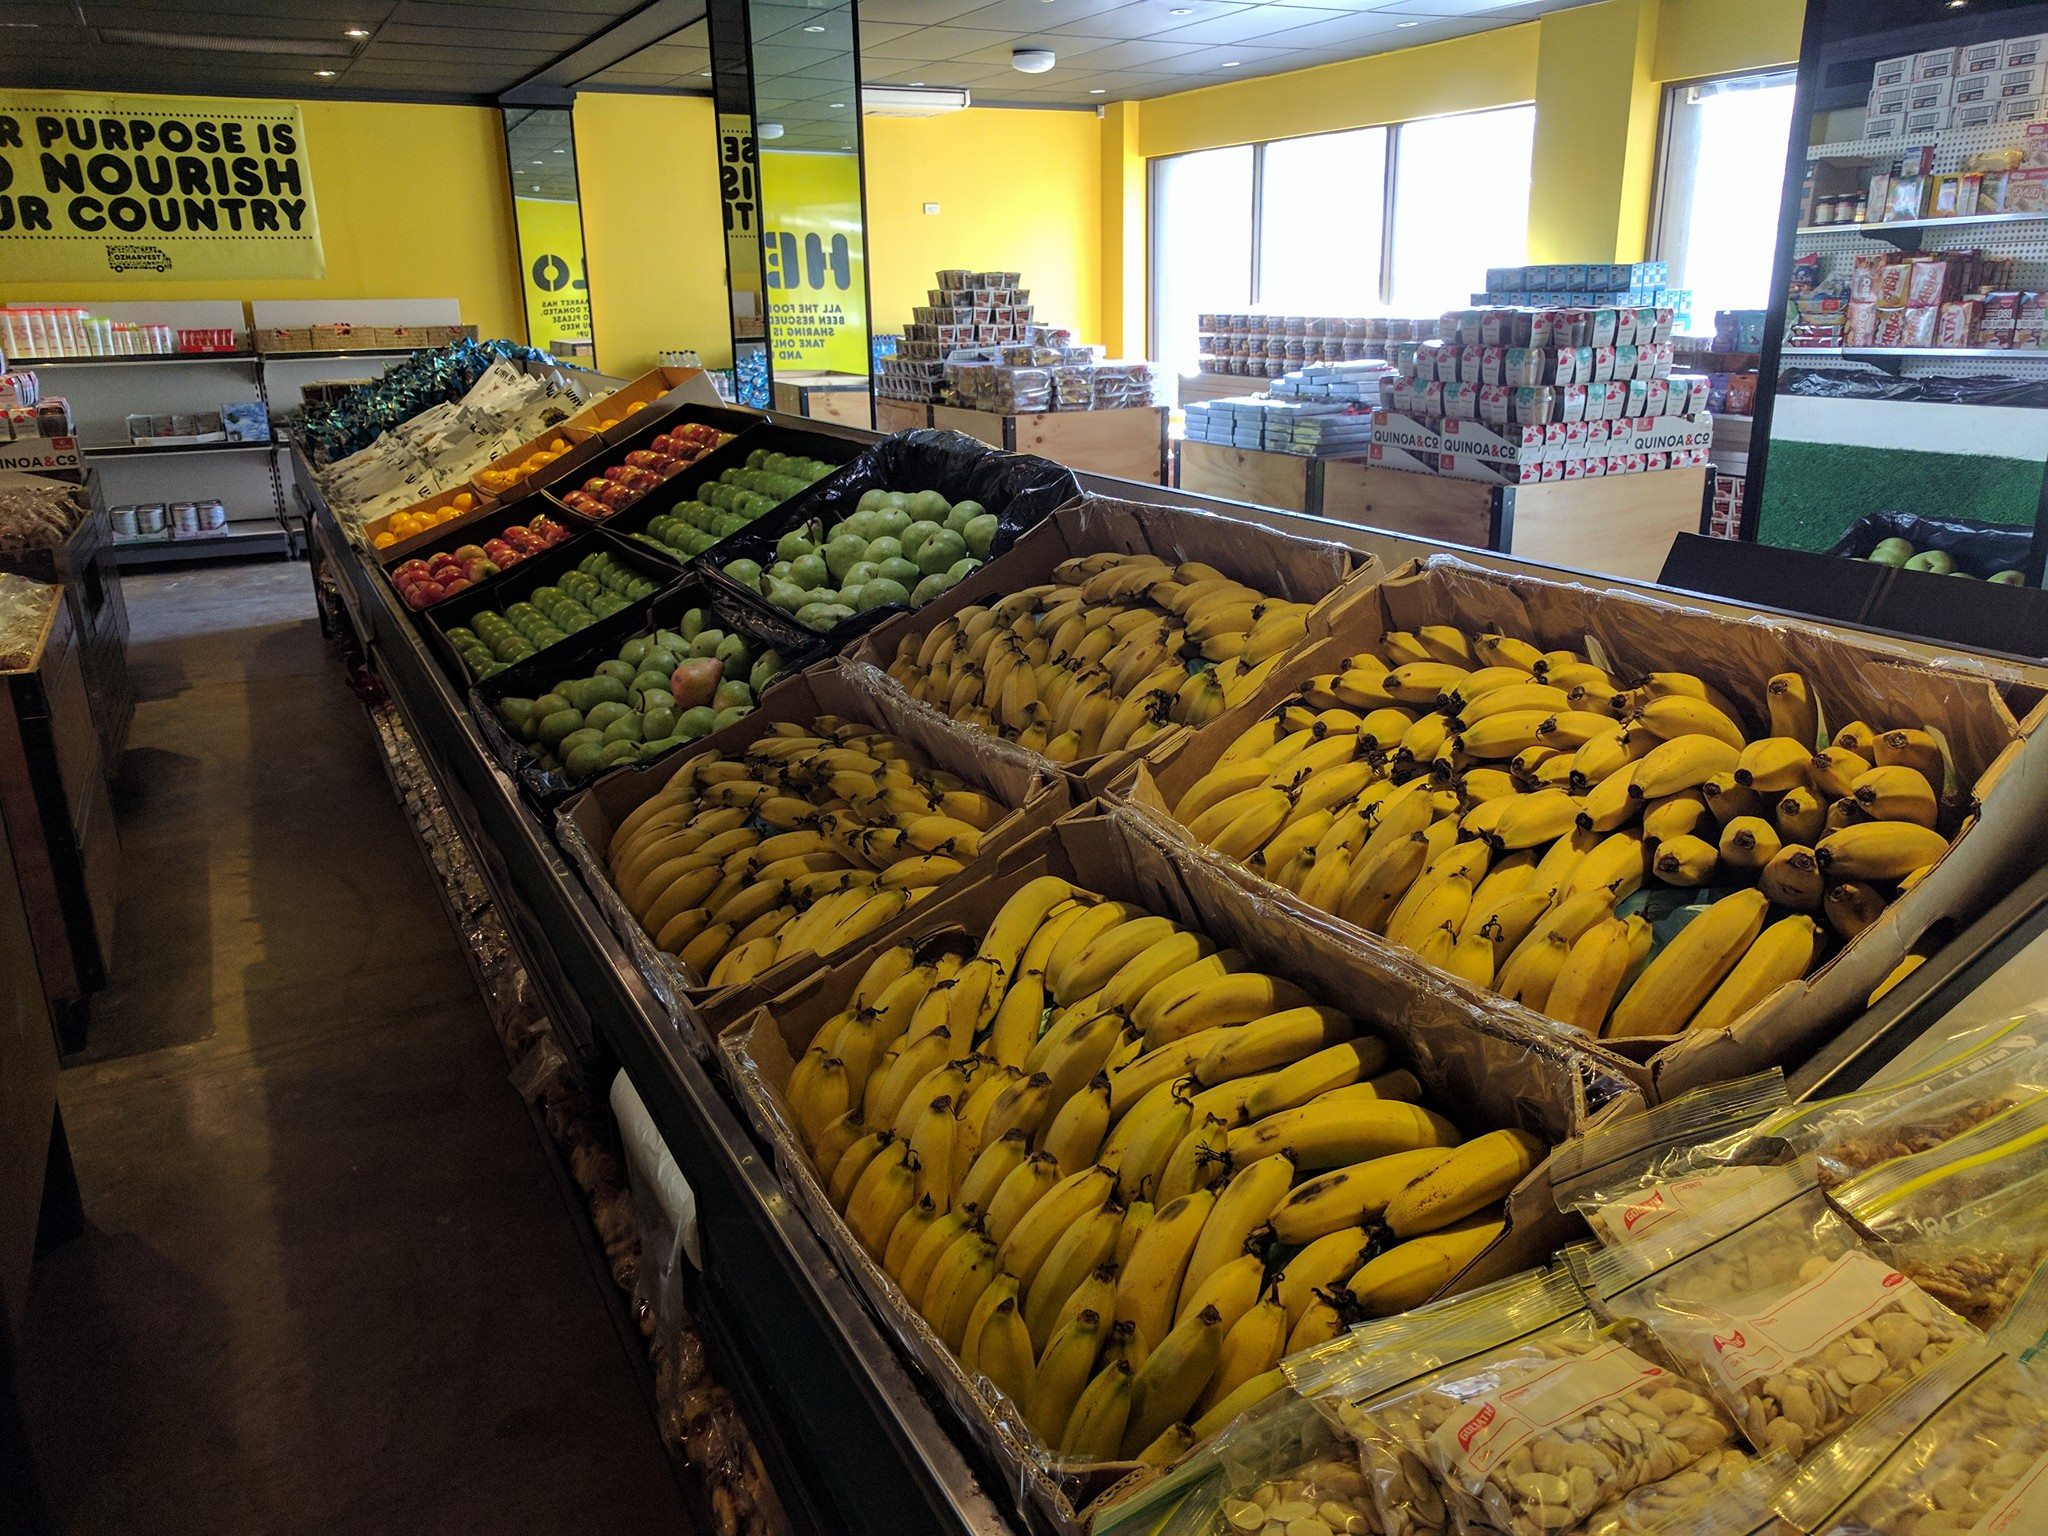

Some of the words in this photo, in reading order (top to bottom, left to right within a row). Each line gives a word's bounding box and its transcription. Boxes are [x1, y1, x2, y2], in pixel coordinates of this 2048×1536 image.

[36, 116, 246, 154] PURPOSE
[257, 123, 297, 155] IS
[40, 152, 302, 196] NOURISH
[68, 196, 306, 232] COUNTRY
[1460, 1404, 1495, 1441] GOLIATH
